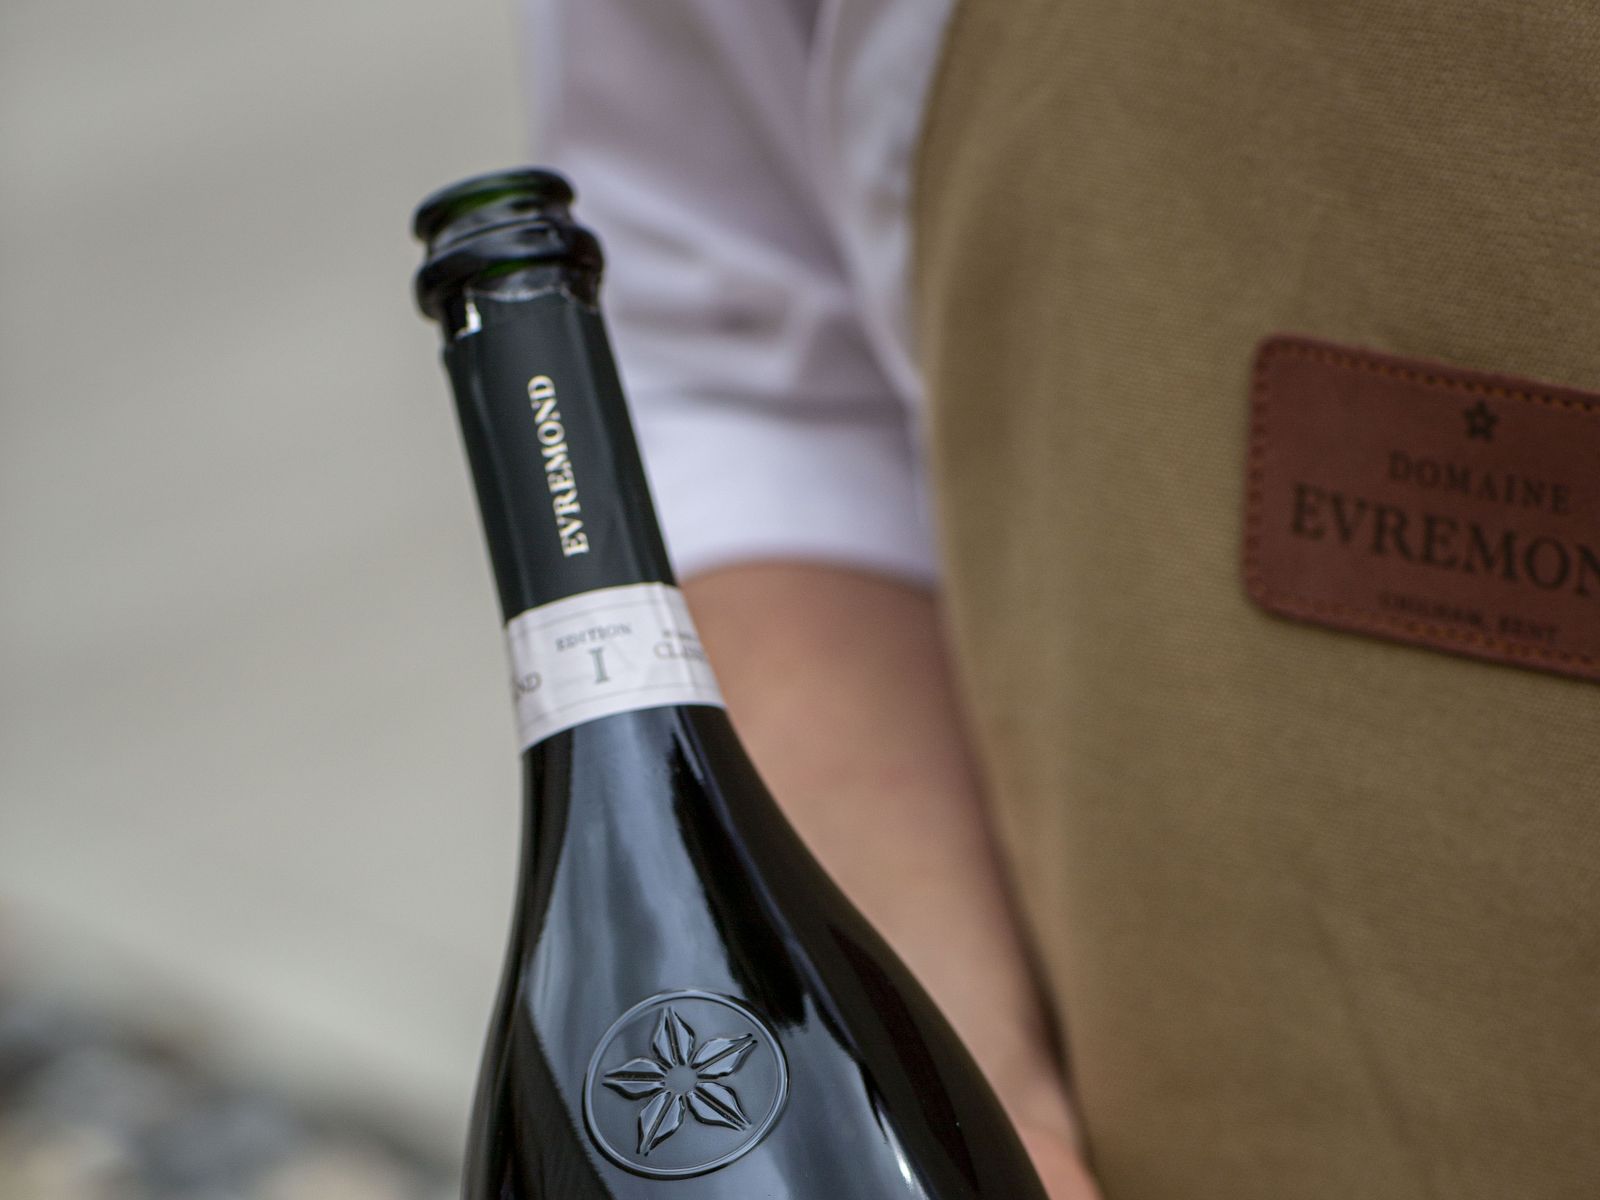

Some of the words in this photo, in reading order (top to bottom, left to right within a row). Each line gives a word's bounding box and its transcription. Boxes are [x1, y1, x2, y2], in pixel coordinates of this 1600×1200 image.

[527, 374, 590, 557] EVREMOND
[1387, 449, 1572, 516] DOMAINE
[555, 622, 633, 652] EDITION
[588, 647, 611, 684] I
